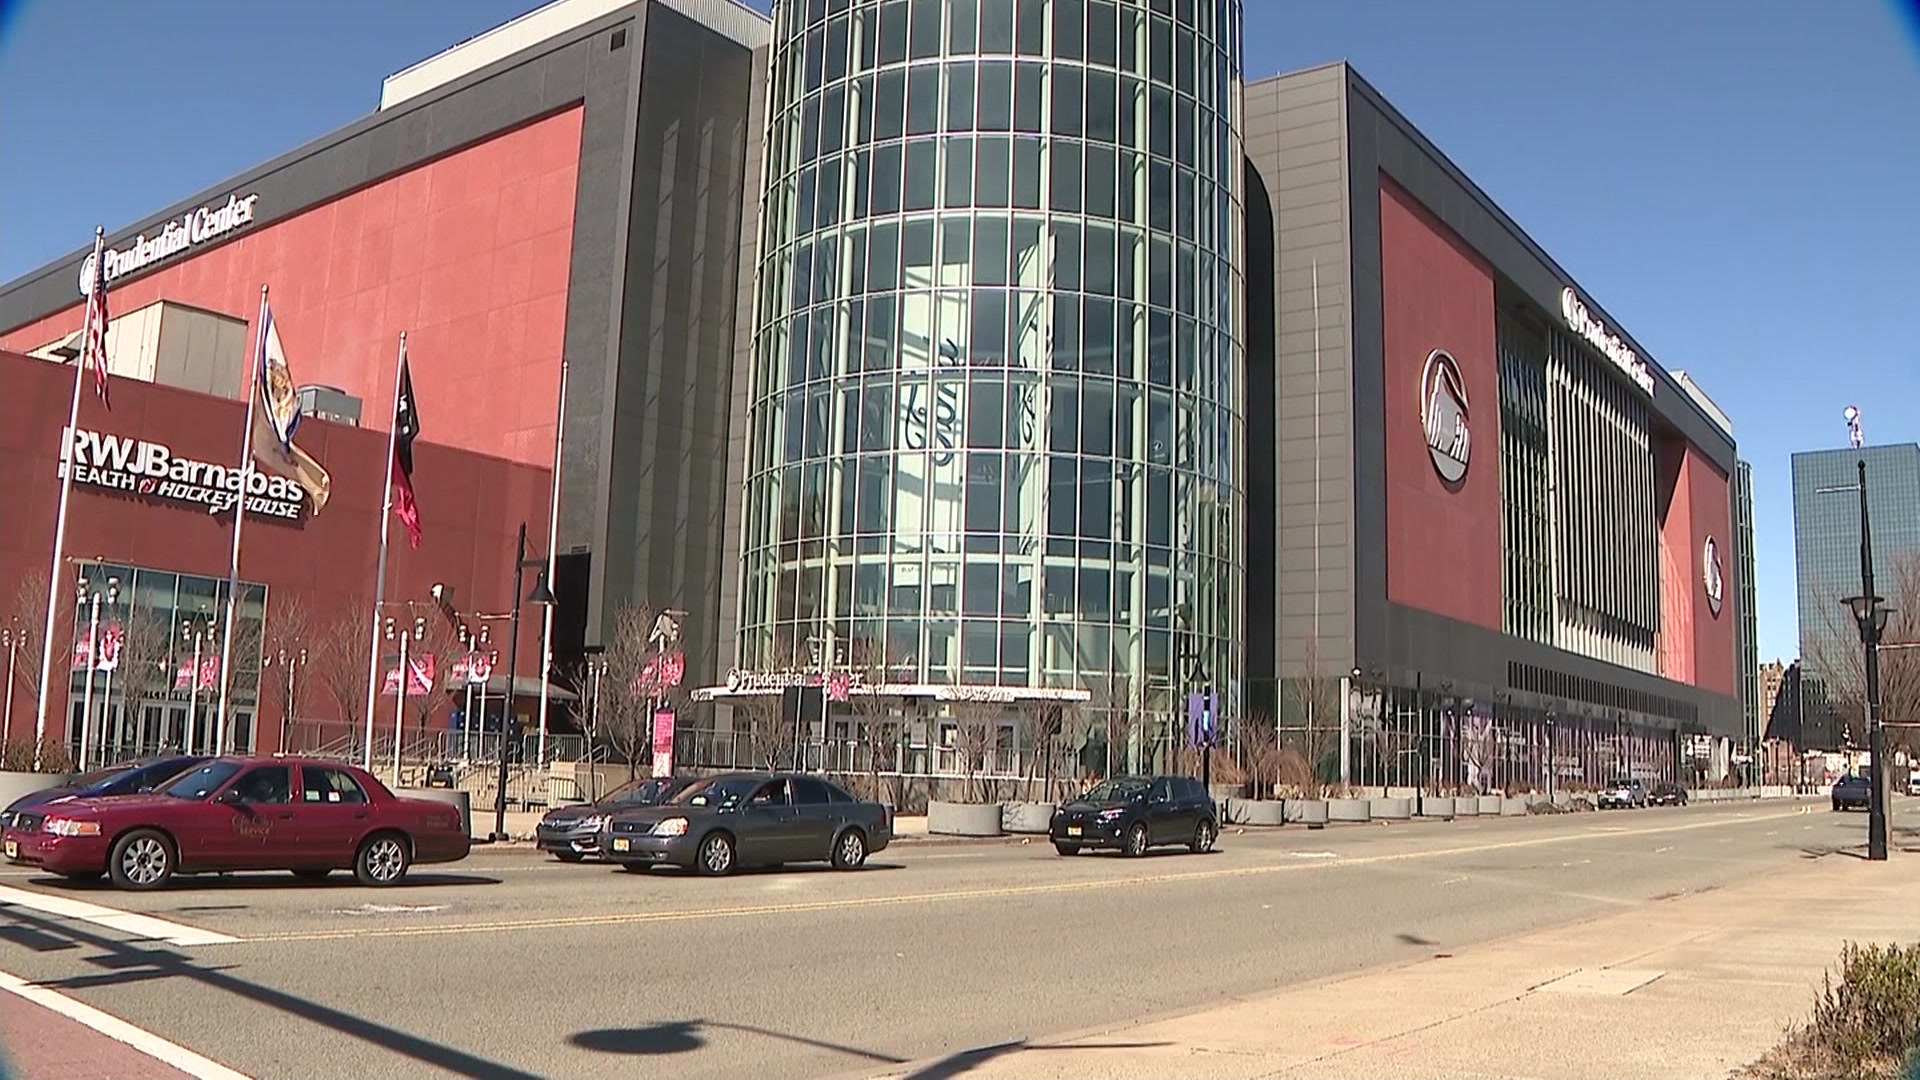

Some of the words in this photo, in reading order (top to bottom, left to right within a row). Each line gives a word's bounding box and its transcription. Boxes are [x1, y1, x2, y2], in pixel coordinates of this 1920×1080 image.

[104, 213, 192, 282] Prudential
[192, 194, 257, 243] Center
[58, 462, 136, 491] HEALTH
[157, 481, 240, 514] HOCKEY
[60, 426, 303, 501] RWJBarnabas
[741, 667, 806, 688] Prudential
[811, 666, 863, 686] eer
